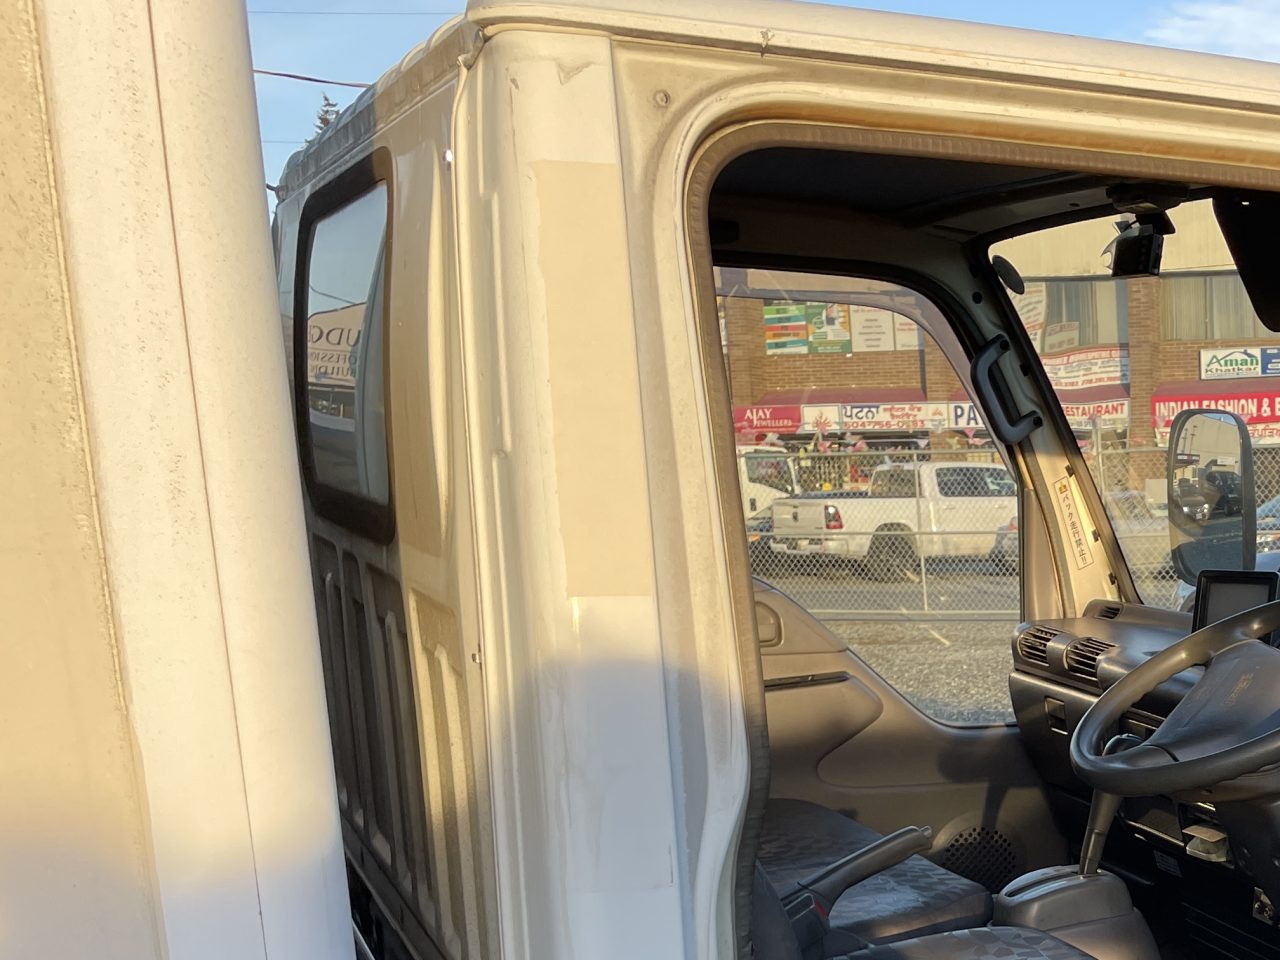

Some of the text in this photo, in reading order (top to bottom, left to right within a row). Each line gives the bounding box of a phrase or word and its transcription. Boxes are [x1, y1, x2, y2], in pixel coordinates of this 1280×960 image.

[1205, 366, 1259, 374] Khatkar
[1208, 355, 1259, 368] Aman
[954, 404, 987, 426] PA
[1202, 398, 1258, 417] FASHION
[1261, 397, 1271, 416] &
[744, 408, 773, 426] AJAY
